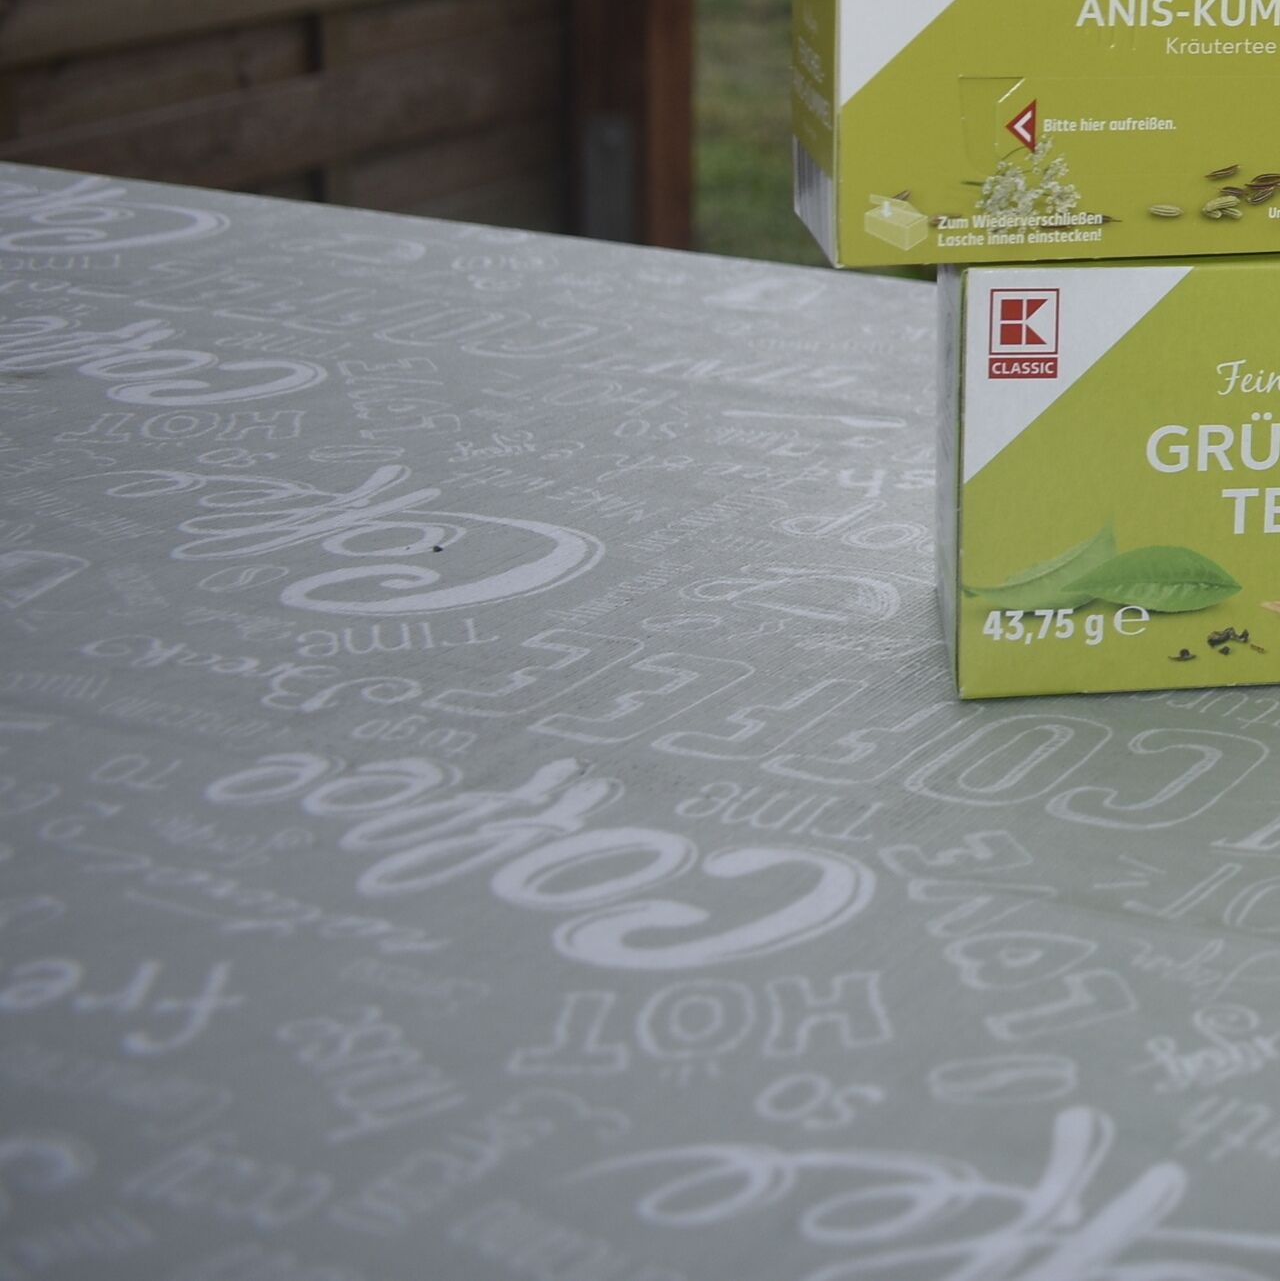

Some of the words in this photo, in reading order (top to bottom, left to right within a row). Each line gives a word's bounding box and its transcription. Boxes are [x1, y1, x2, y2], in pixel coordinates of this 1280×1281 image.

[1166, 37, 1278, 55] Kräutertee
[1044, 119, 1077, 133] Bitte
[1080, 118, 1105, 132] hier
[1109, 116, 1177, 132] aufreißen.
[937, 216, 969, 230] Zum
[972, 212, 1103, 230] Wiederverschließen
[937, 233, 984, 248] Lasche
[986, 232, 1024, 245] innen
[1027, 229, 1101, 244] einstecken!
[992, 361, 1055, 375] CLASSIC
[85, 465, 604, 616] Coffee
[983, 608, 1075, 644] 43,75
[1085, 613, 1104, 645] g
[205, 757, 874, 968] Coffee
[507, 971, 894, 1083] HOT
